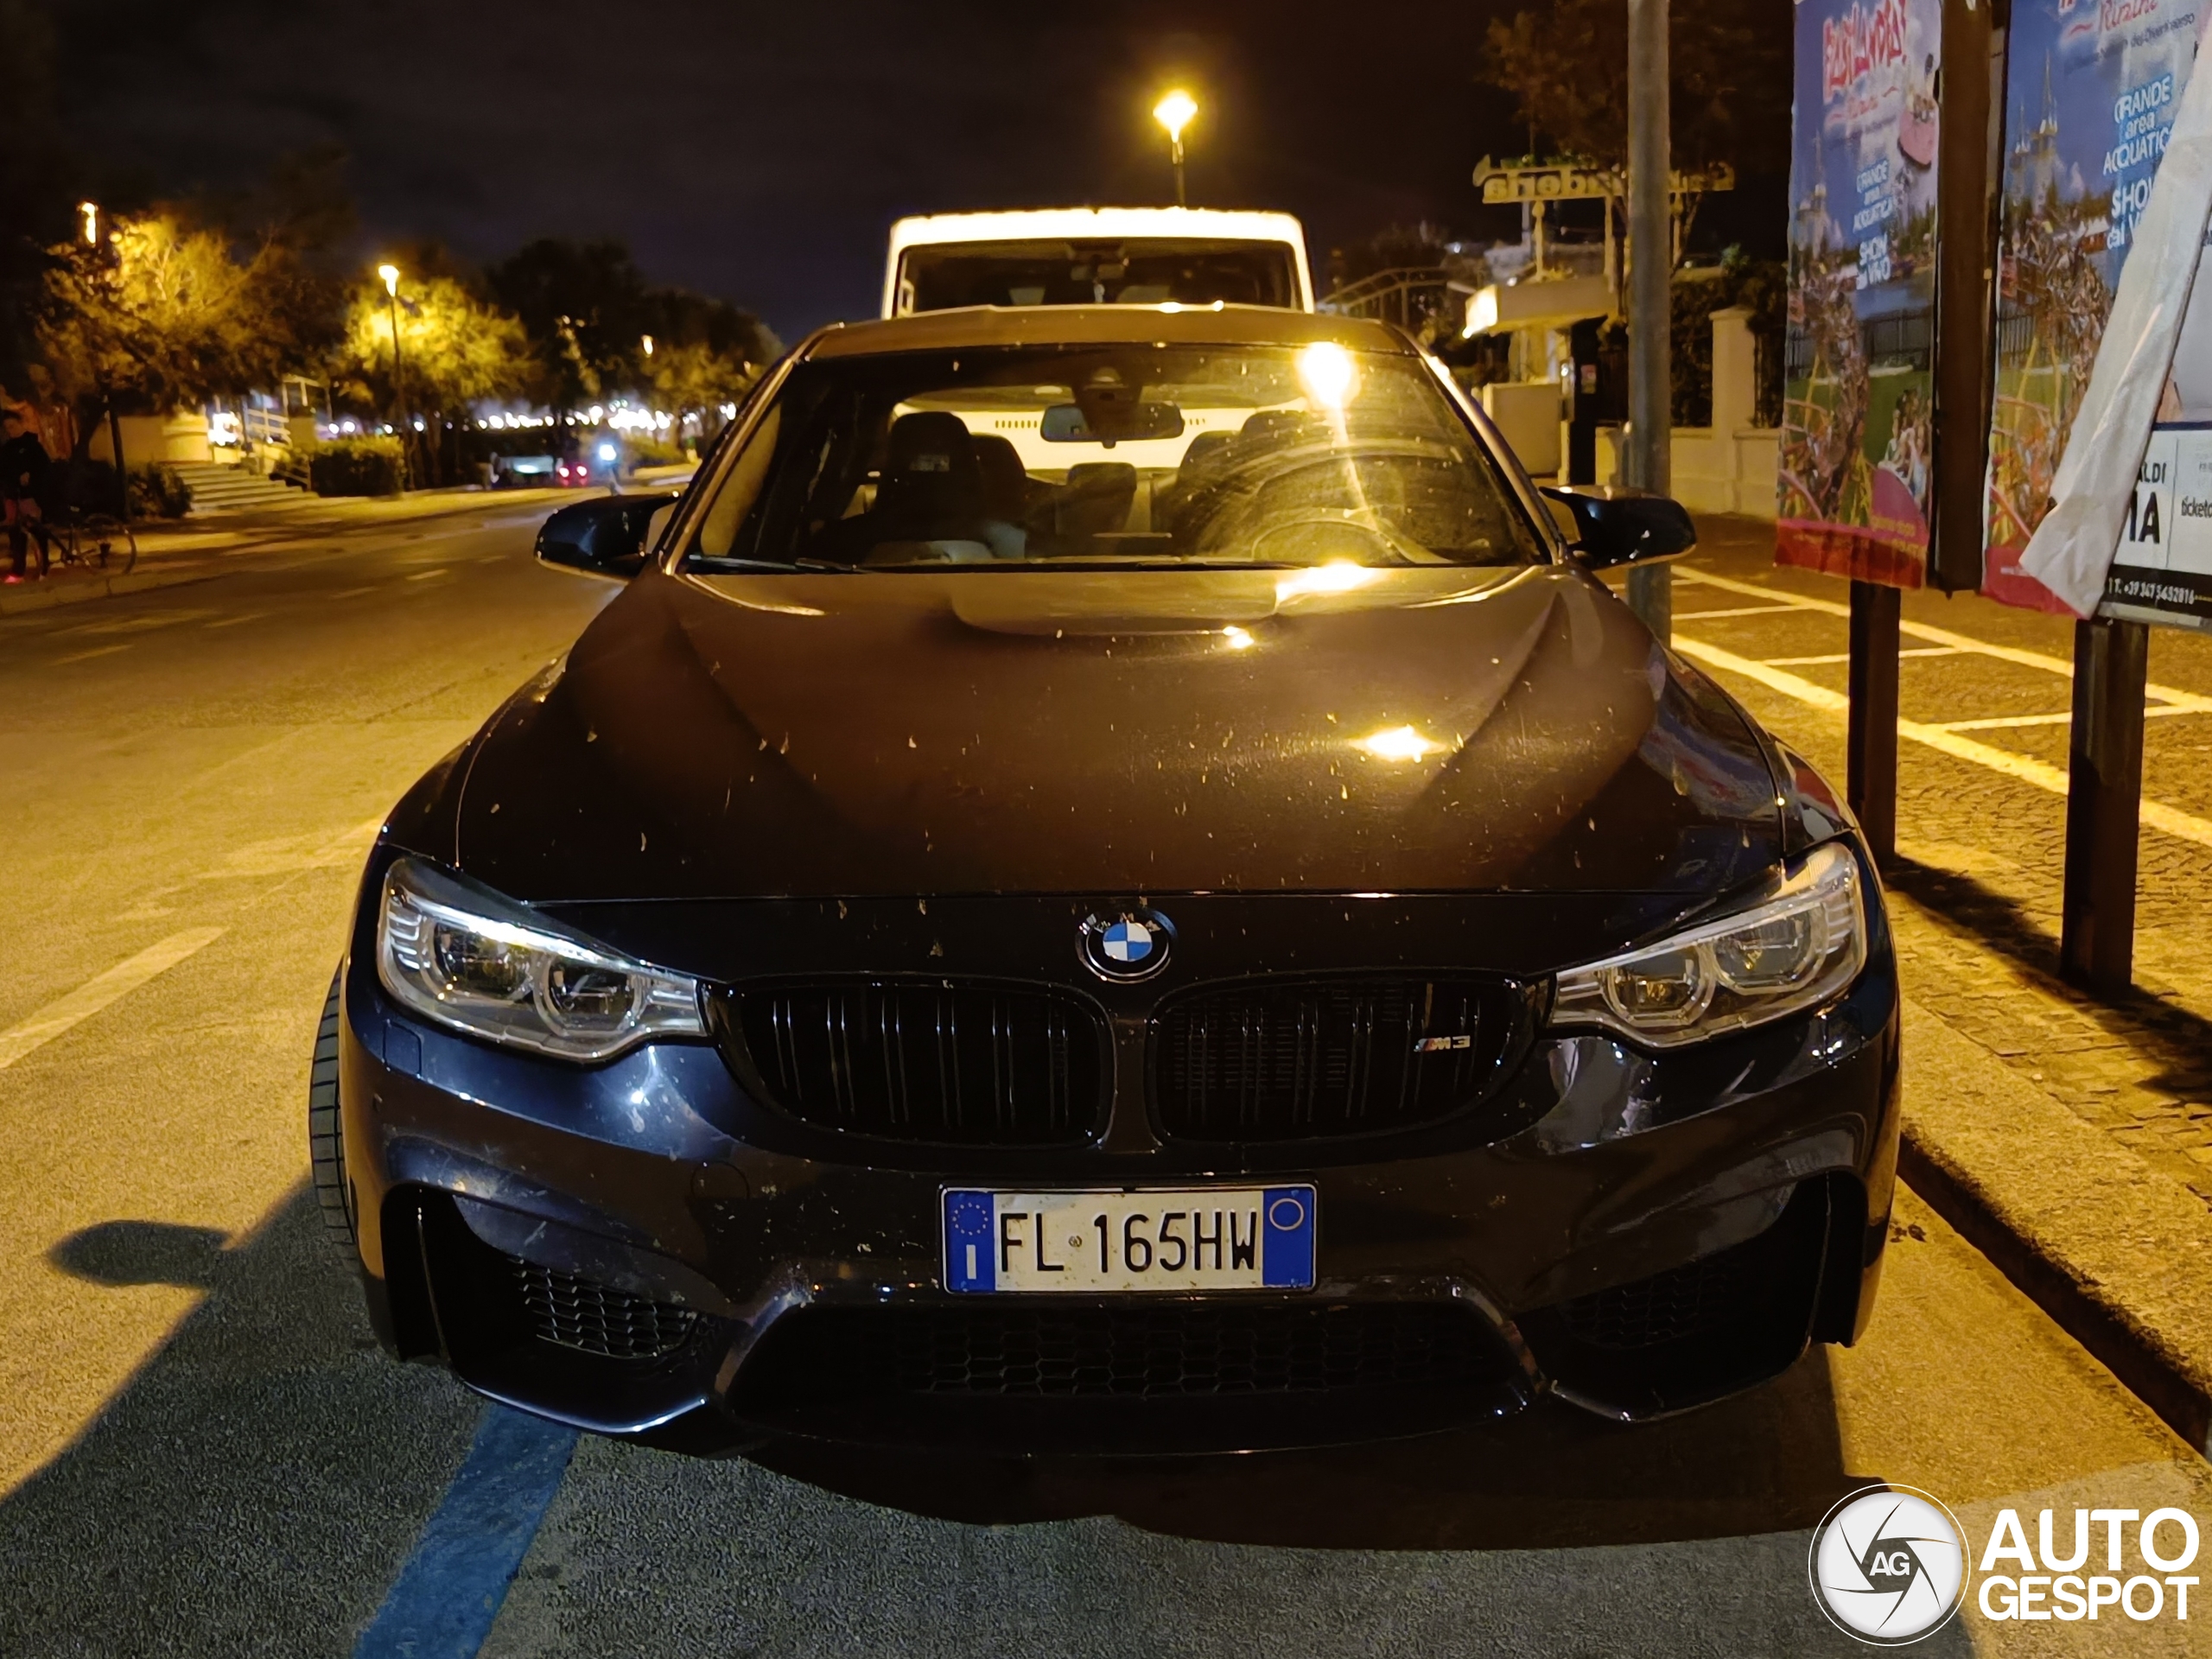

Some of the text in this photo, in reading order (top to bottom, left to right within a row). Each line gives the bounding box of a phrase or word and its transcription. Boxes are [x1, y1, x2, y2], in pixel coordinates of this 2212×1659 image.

[2125, 111, 2156, 141] area
[1000, 1212, 1065, 1272] FL
[1093, 1206, 1257, 1274] 165HW
